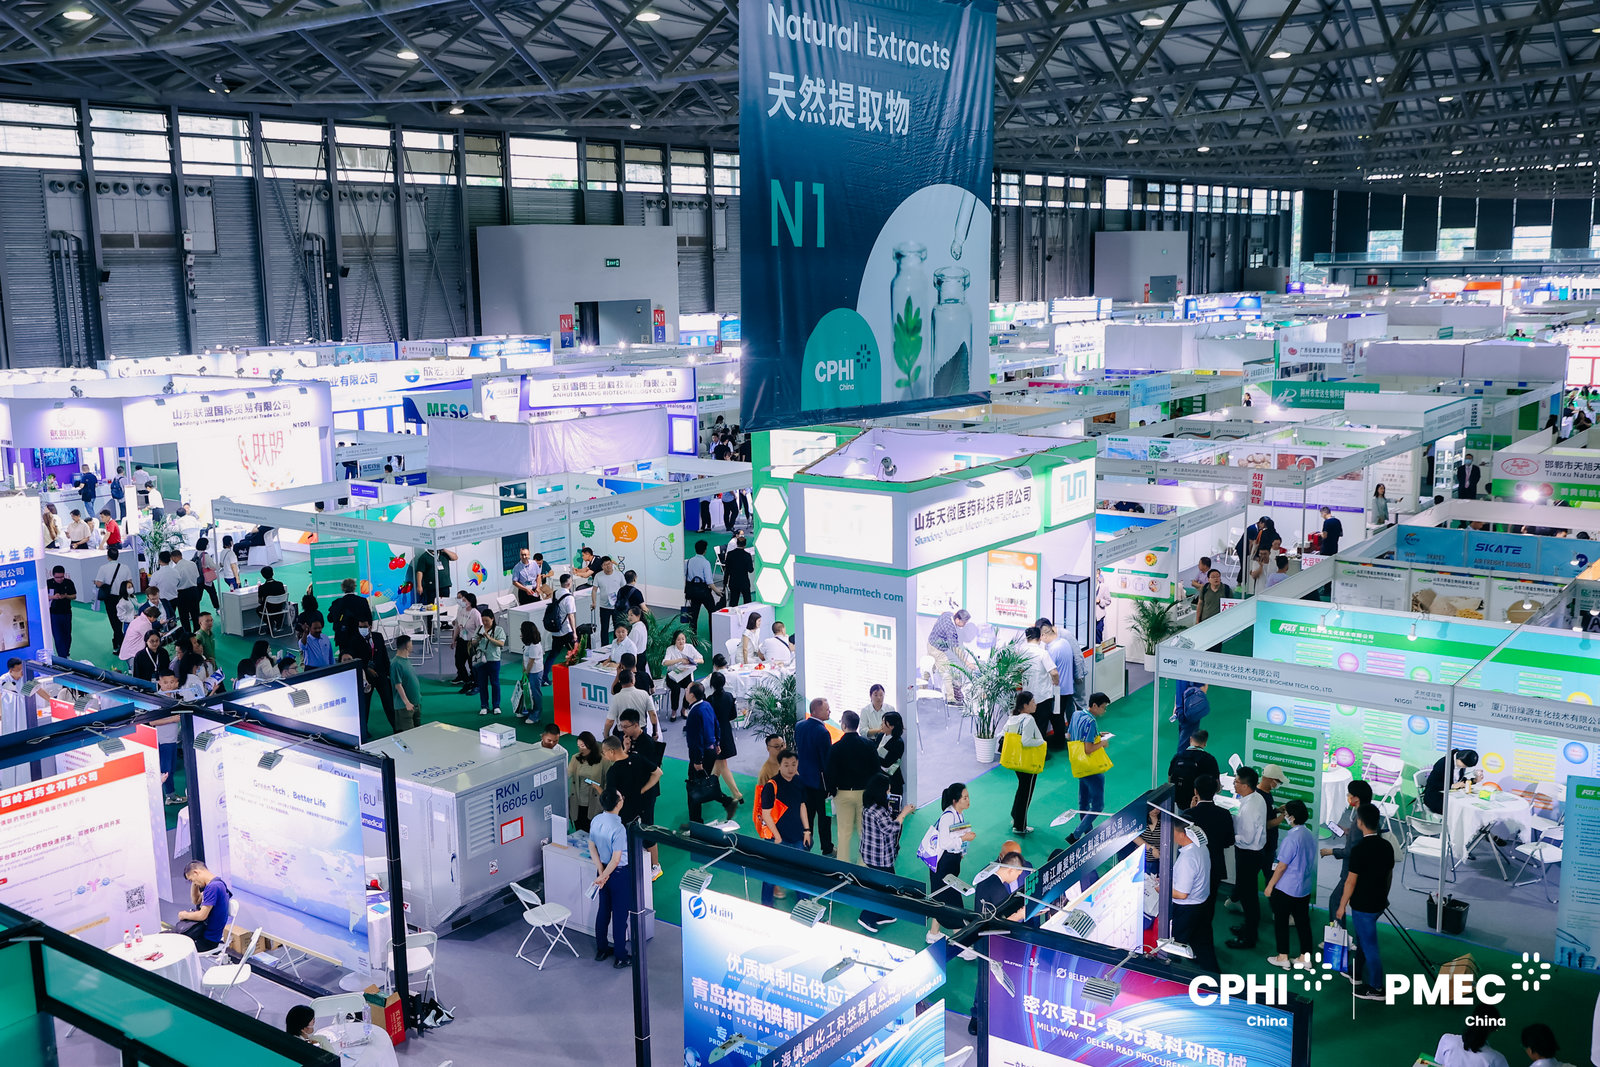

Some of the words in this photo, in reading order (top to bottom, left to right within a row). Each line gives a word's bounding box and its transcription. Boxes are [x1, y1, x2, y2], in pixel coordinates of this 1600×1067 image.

[767, 3, 858, 54] Natural
[866, 27, 951, 71] Extracts
[767, 71, 911, 136] 天然提取物
[770, 178, 826, 249] N1
[561, 318, 572, 329] N1
[655, 313, 664, 323] N1
[565, 336, 570, 346] 2
[815, 359, 855, 384] CPHI
[839, 383, 855, 391] China
[1545, 470, 1572, 478] Tianxu
[914, 486, 1032, 531] 山东天微医药科技有限公司
[914, 530, 943, 546] Shandong
[1475, 543, 1523, 555] SKATE
[1188, 658, 1280, 679] 厦门恒绿源生化技术有限公司
[1189, 667, 1208, 676] XIAMEN
[1208, 670, 1230, 678] FOREVER
[1230, 673, 1248, 681] GREEN
[1248, 676, 1269, 684] SOURCE
[1269, 679, 1294, 687] BIOCHEM
[1458, 701, 1477, 710] CPHI
[1491, 702, 1600, 725] 厦门恒绿源生化技术有限公
[1490, 712, 1514, 721] XIAMEN
[1514, 715, 1542, 724] FOREVER
[1543, 719, 1564, 728] GREEN
[1565, 722, 1591, 732] SOURCE
[411, 765, 441, 778] RKN
[272, 785, 286, 796] Tech
[293, 791, 314, 804] Better
[314, 797, 327, 808] Life
[495, 781, 520, 801] RKN
[496, 793, 528, 815] 16605
[529, 787, 545, 802] 6U
[1061, 862, 1079, 879] CONNECT
[727, 974, 741, 983] HIGH
[742, 979, 764, 990] QUALITY
[785, 993, 814, 1008] PRODUCTS
[694, 1001, 733, 1021] QINGDAO
[736, 1016, 771, 1035] TOCEAN
[801, 1033, 842, 1067] Sinoprinciple
[842, 1014, 870, 1039] Chemical
[870, 991, 902, 1020] Technology
[1036, 1021, 1079, 1040] MILKYWAY
[1116, 1044, 1134, 1058] R&D
